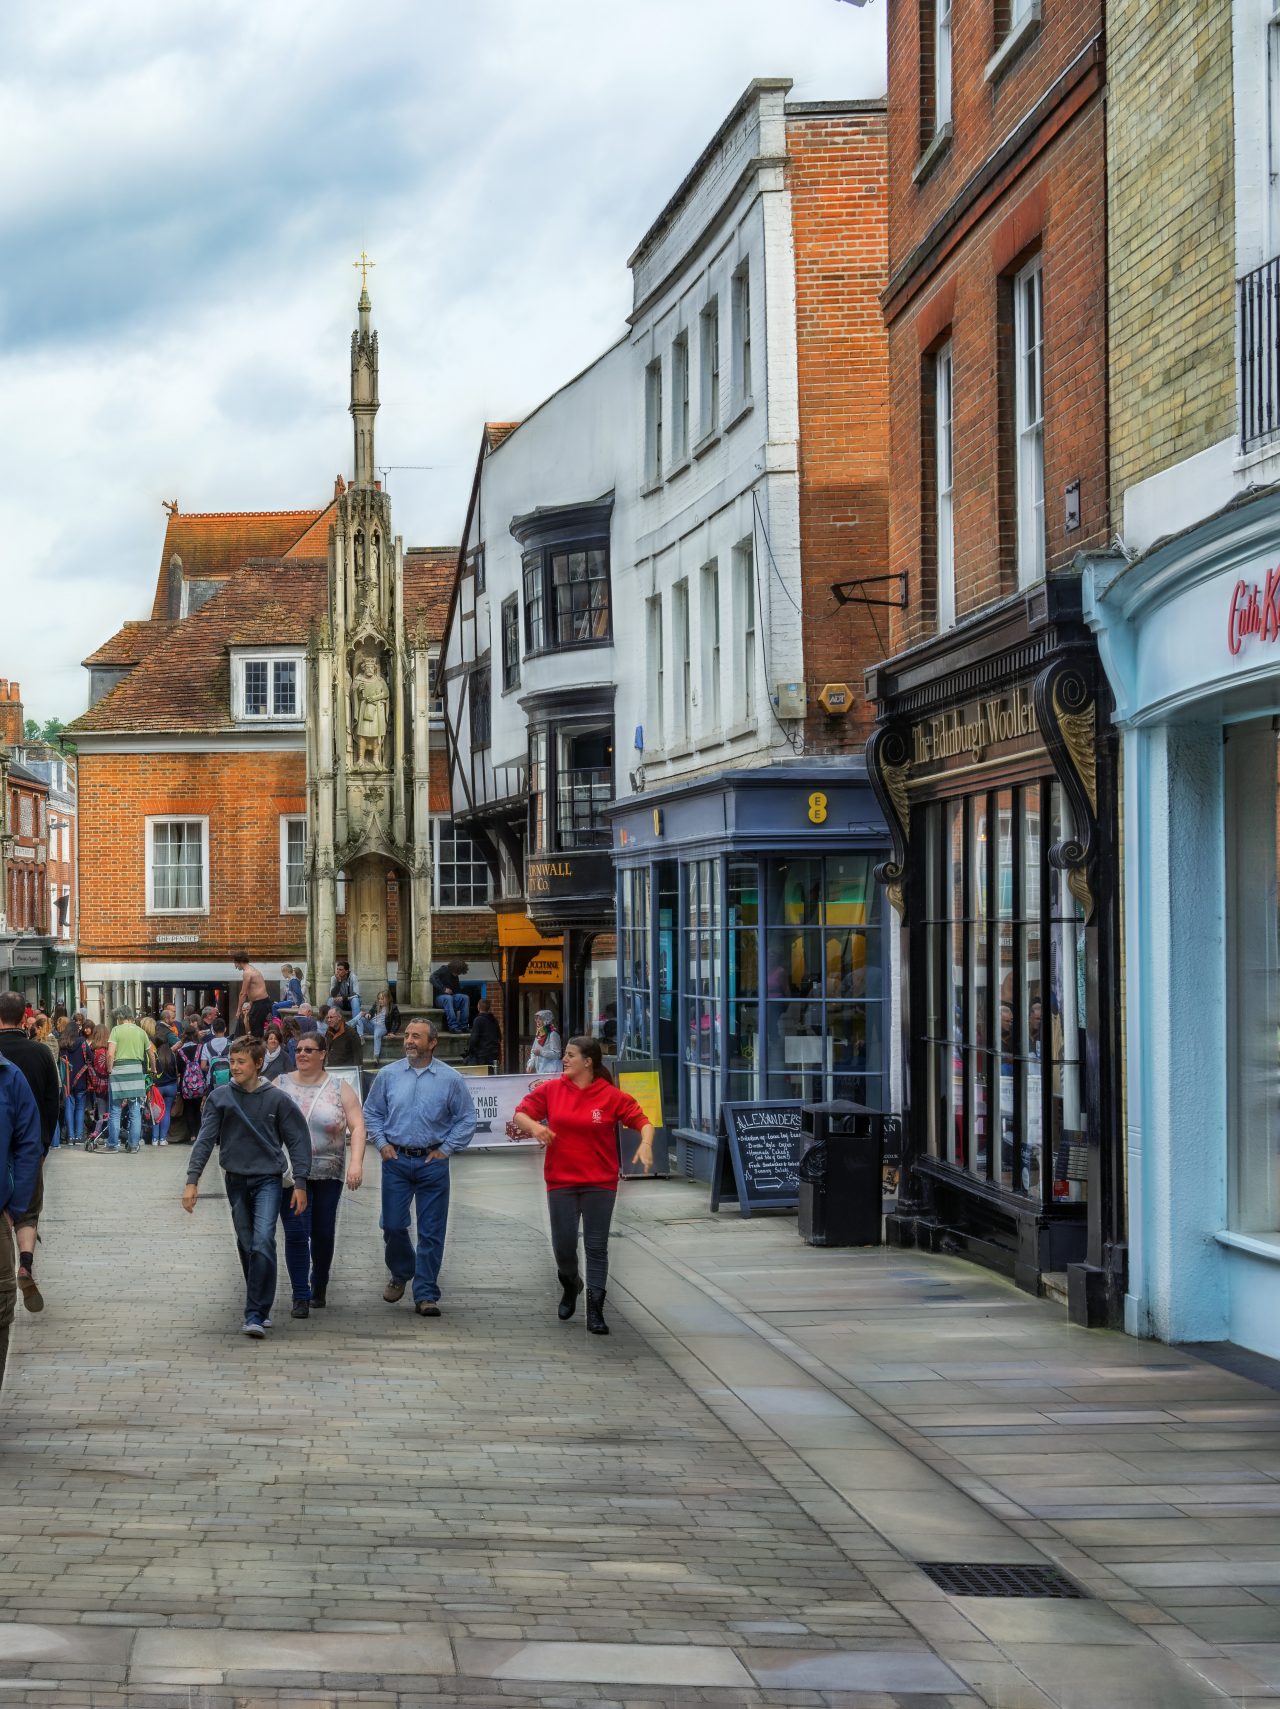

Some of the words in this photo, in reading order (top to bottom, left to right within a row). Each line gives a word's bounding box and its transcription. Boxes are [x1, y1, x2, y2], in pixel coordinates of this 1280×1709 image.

[1228, 580, 1260, 655] Cath
[828, 693, 845, 704] ADT
[912, 721, 930, 764] The
[932, 702, 987, 763] Edinburgh
[986, 687, 1038, 743] Woollen
[528, 863, 572, 877] RNWALL
[528, 961, 559, 969] OCCITANE
[477, 1096, 498, 1107] MADE
[483, 1107, 498, 1118] YOU
[736, 1113, 801, 1129] ALEXANDER'S
